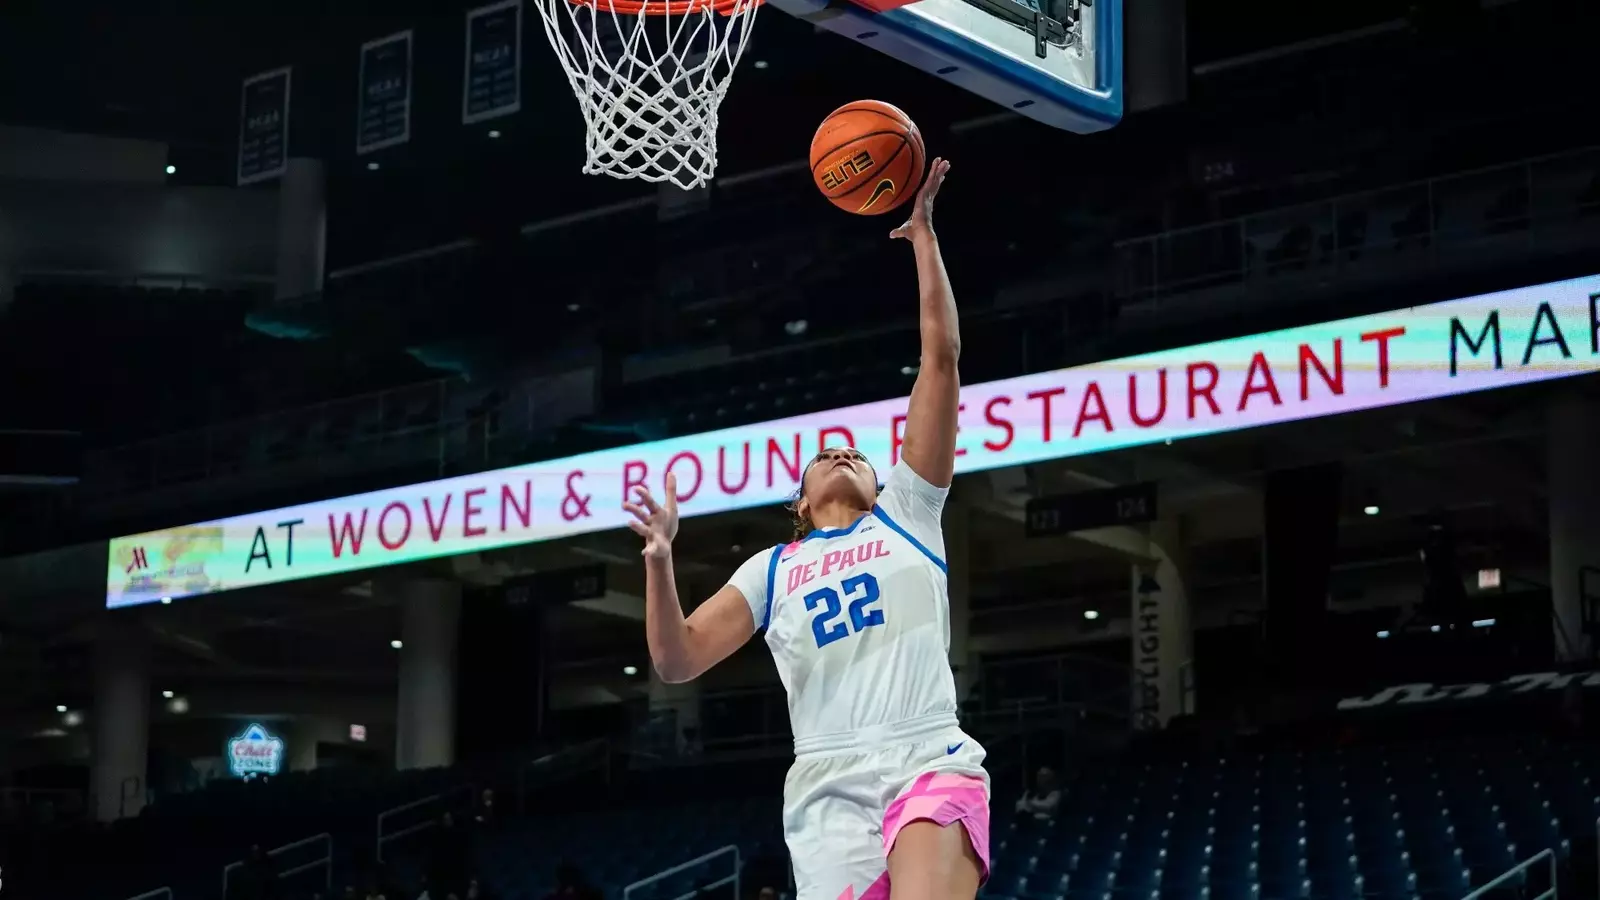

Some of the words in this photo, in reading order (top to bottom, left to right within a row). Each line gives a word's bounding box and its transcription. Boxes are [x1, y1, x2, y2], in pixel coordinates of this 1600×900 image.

[821, 150, 875, 192] ELITE
[245, 518, 304, 574] AT
[328, 480, 532, 559] WOVEN
[560, 469, 592, 522] &
[891, 326, 1406, 467] STAURANT
[803, 572, 885, 649] 22
[1138, 598, 1159, 679] LIGHT
